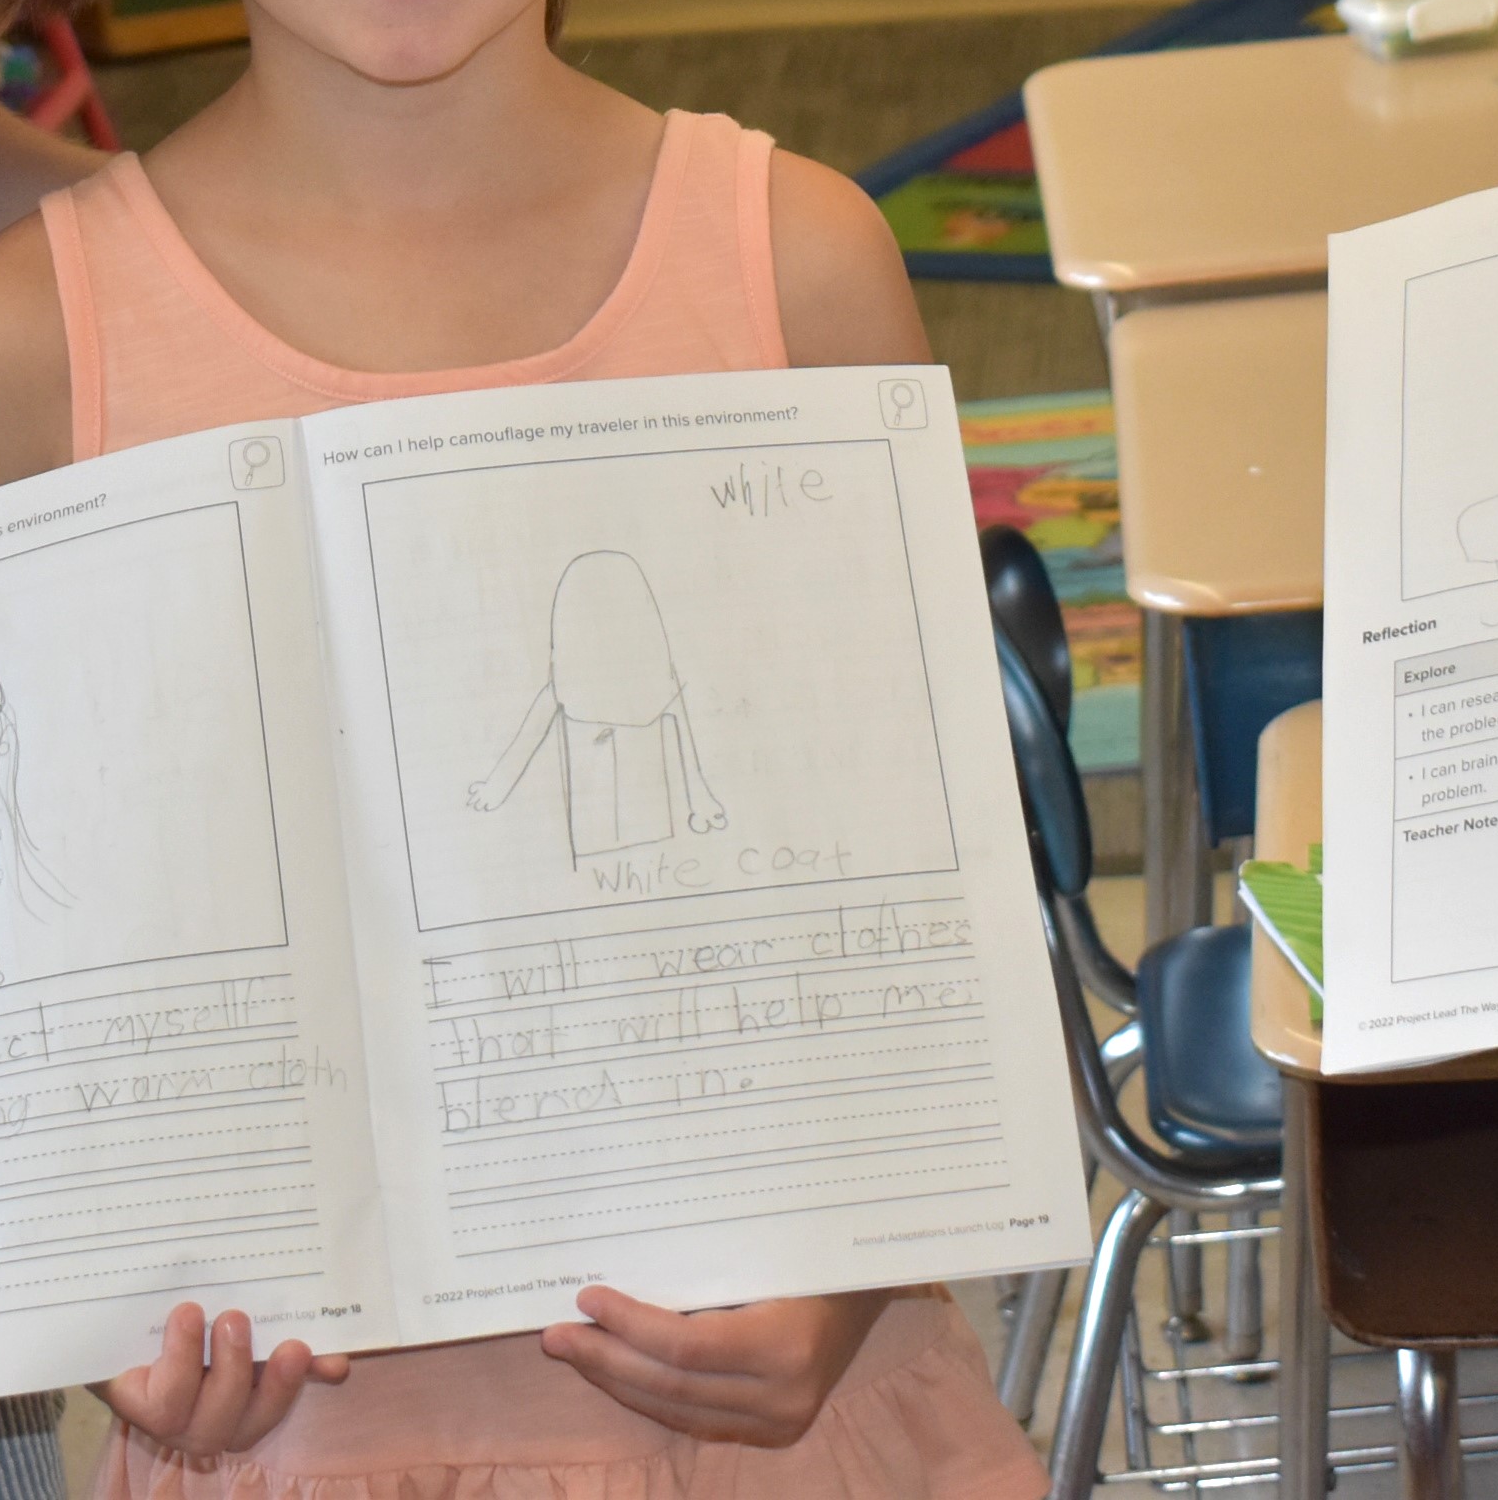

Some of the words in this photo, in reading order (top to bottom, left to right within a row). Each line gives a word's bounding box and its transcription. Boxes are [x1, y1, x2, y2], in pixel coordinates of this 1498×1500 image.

[323, 447, 358, 466] How
[364, 443, 393, 458] can
[407, 434, 444, 453] help
[449, 423, 545, 448] camouflage
[550, 423, 572, 440] my
[577, 416, 638, 434] traveler
[643, 415, 658, 430] in
[662, 412, 690, 428] this
[695, 405, 799, 427] environment?
[7, 493, 107, 533] environment?
[1362, 617, 1437, 645] Reflection
[1403, 662, 1457, 686] Explore
[1430, 700, 1456, 716] can
[1421, 726, 1445, 743] the
[1430, 763, 1456, 779] can
[1421, 780, 1487, 807] problem.
[1403, 822, 1459, 843] Teacher
[502, 938, 579, 1000] will
[653, 937, 772, 979] wear
[452, 1004, 570, 1067] that
[619, 986, 701, 1044] will
[732, 970, 842, 1034] help
[1009, 1217, 1036, 1228] Page
[1038, 1214, 1050, 1224] 19
